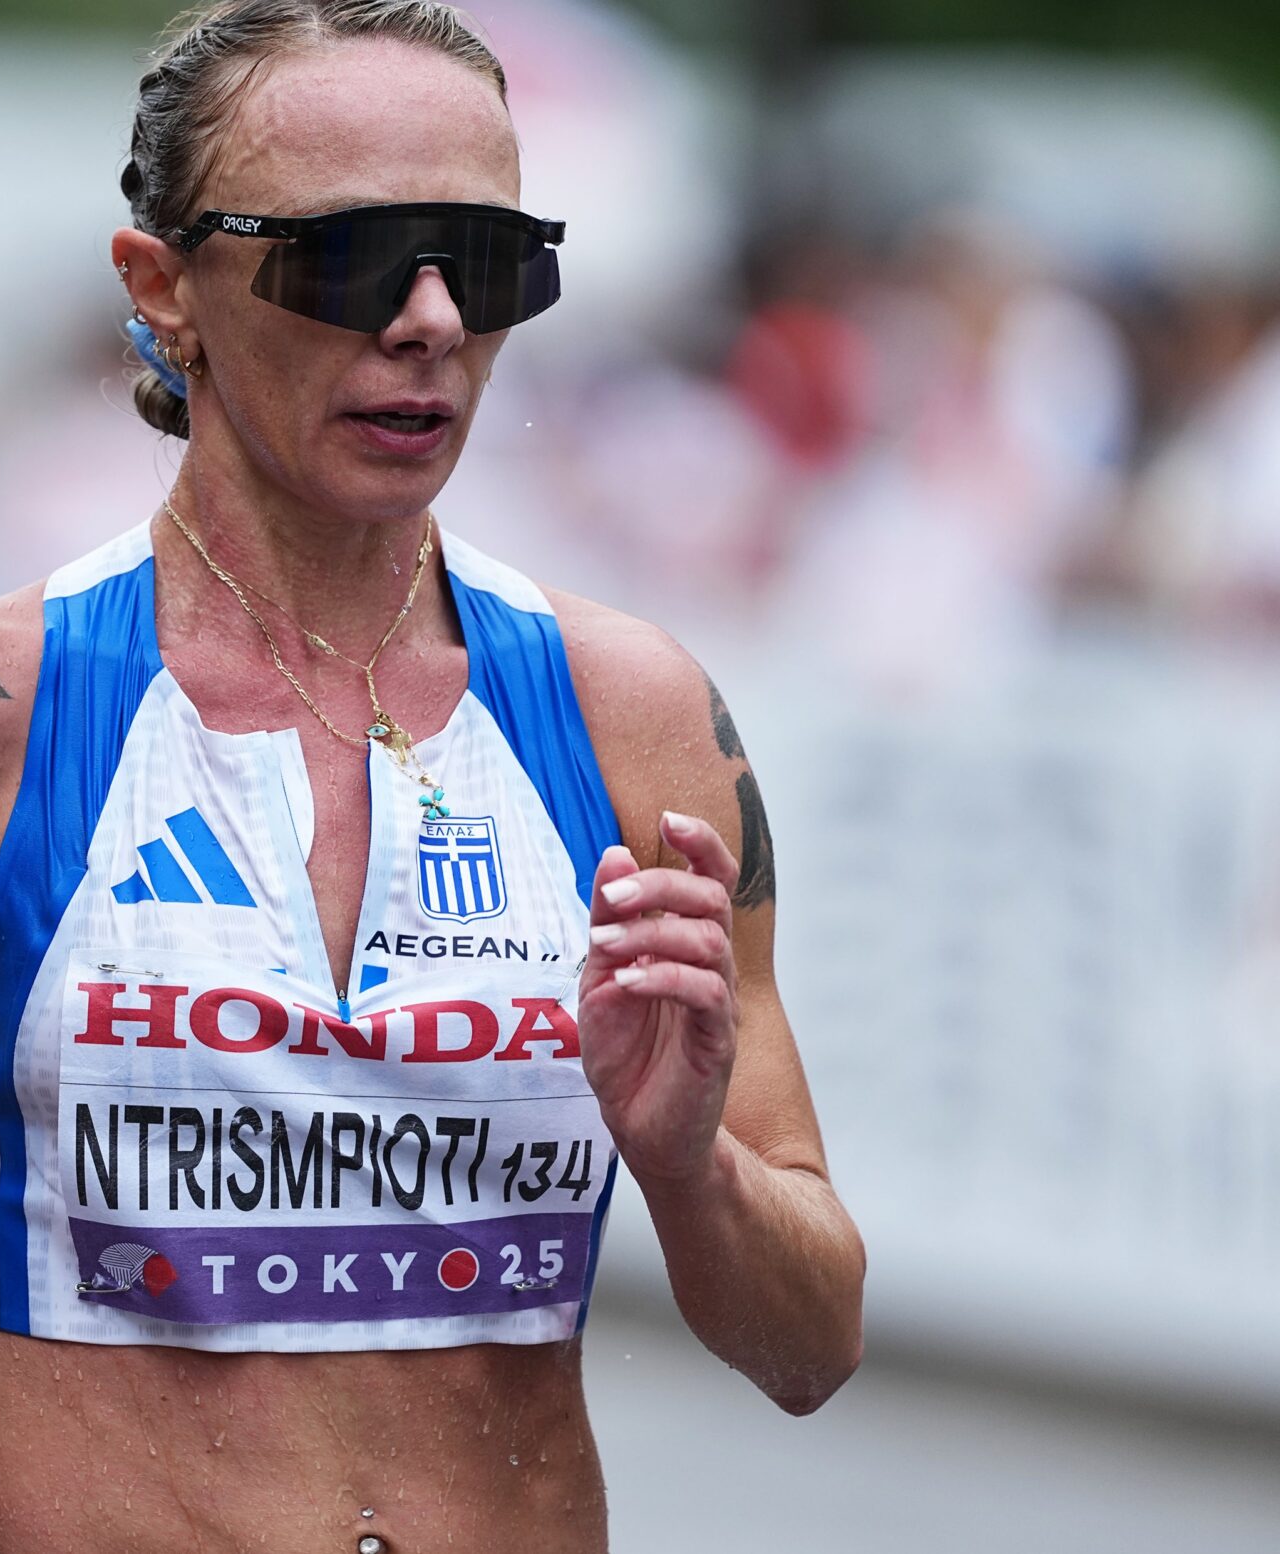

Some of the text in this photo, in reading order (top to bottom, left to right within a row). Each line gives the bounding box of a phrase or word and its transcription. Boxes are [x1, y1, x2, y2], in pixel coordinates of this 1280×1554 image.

[222, 215, 262, 233] OAKLEY
[365, 931, 528, 961] AEGEAN
[73, 982, 582, 1063] HONDA
[75, 1102, 593, 1212] NTRISMPIOTI 134
[499, 1239, 564, 1285] 25
